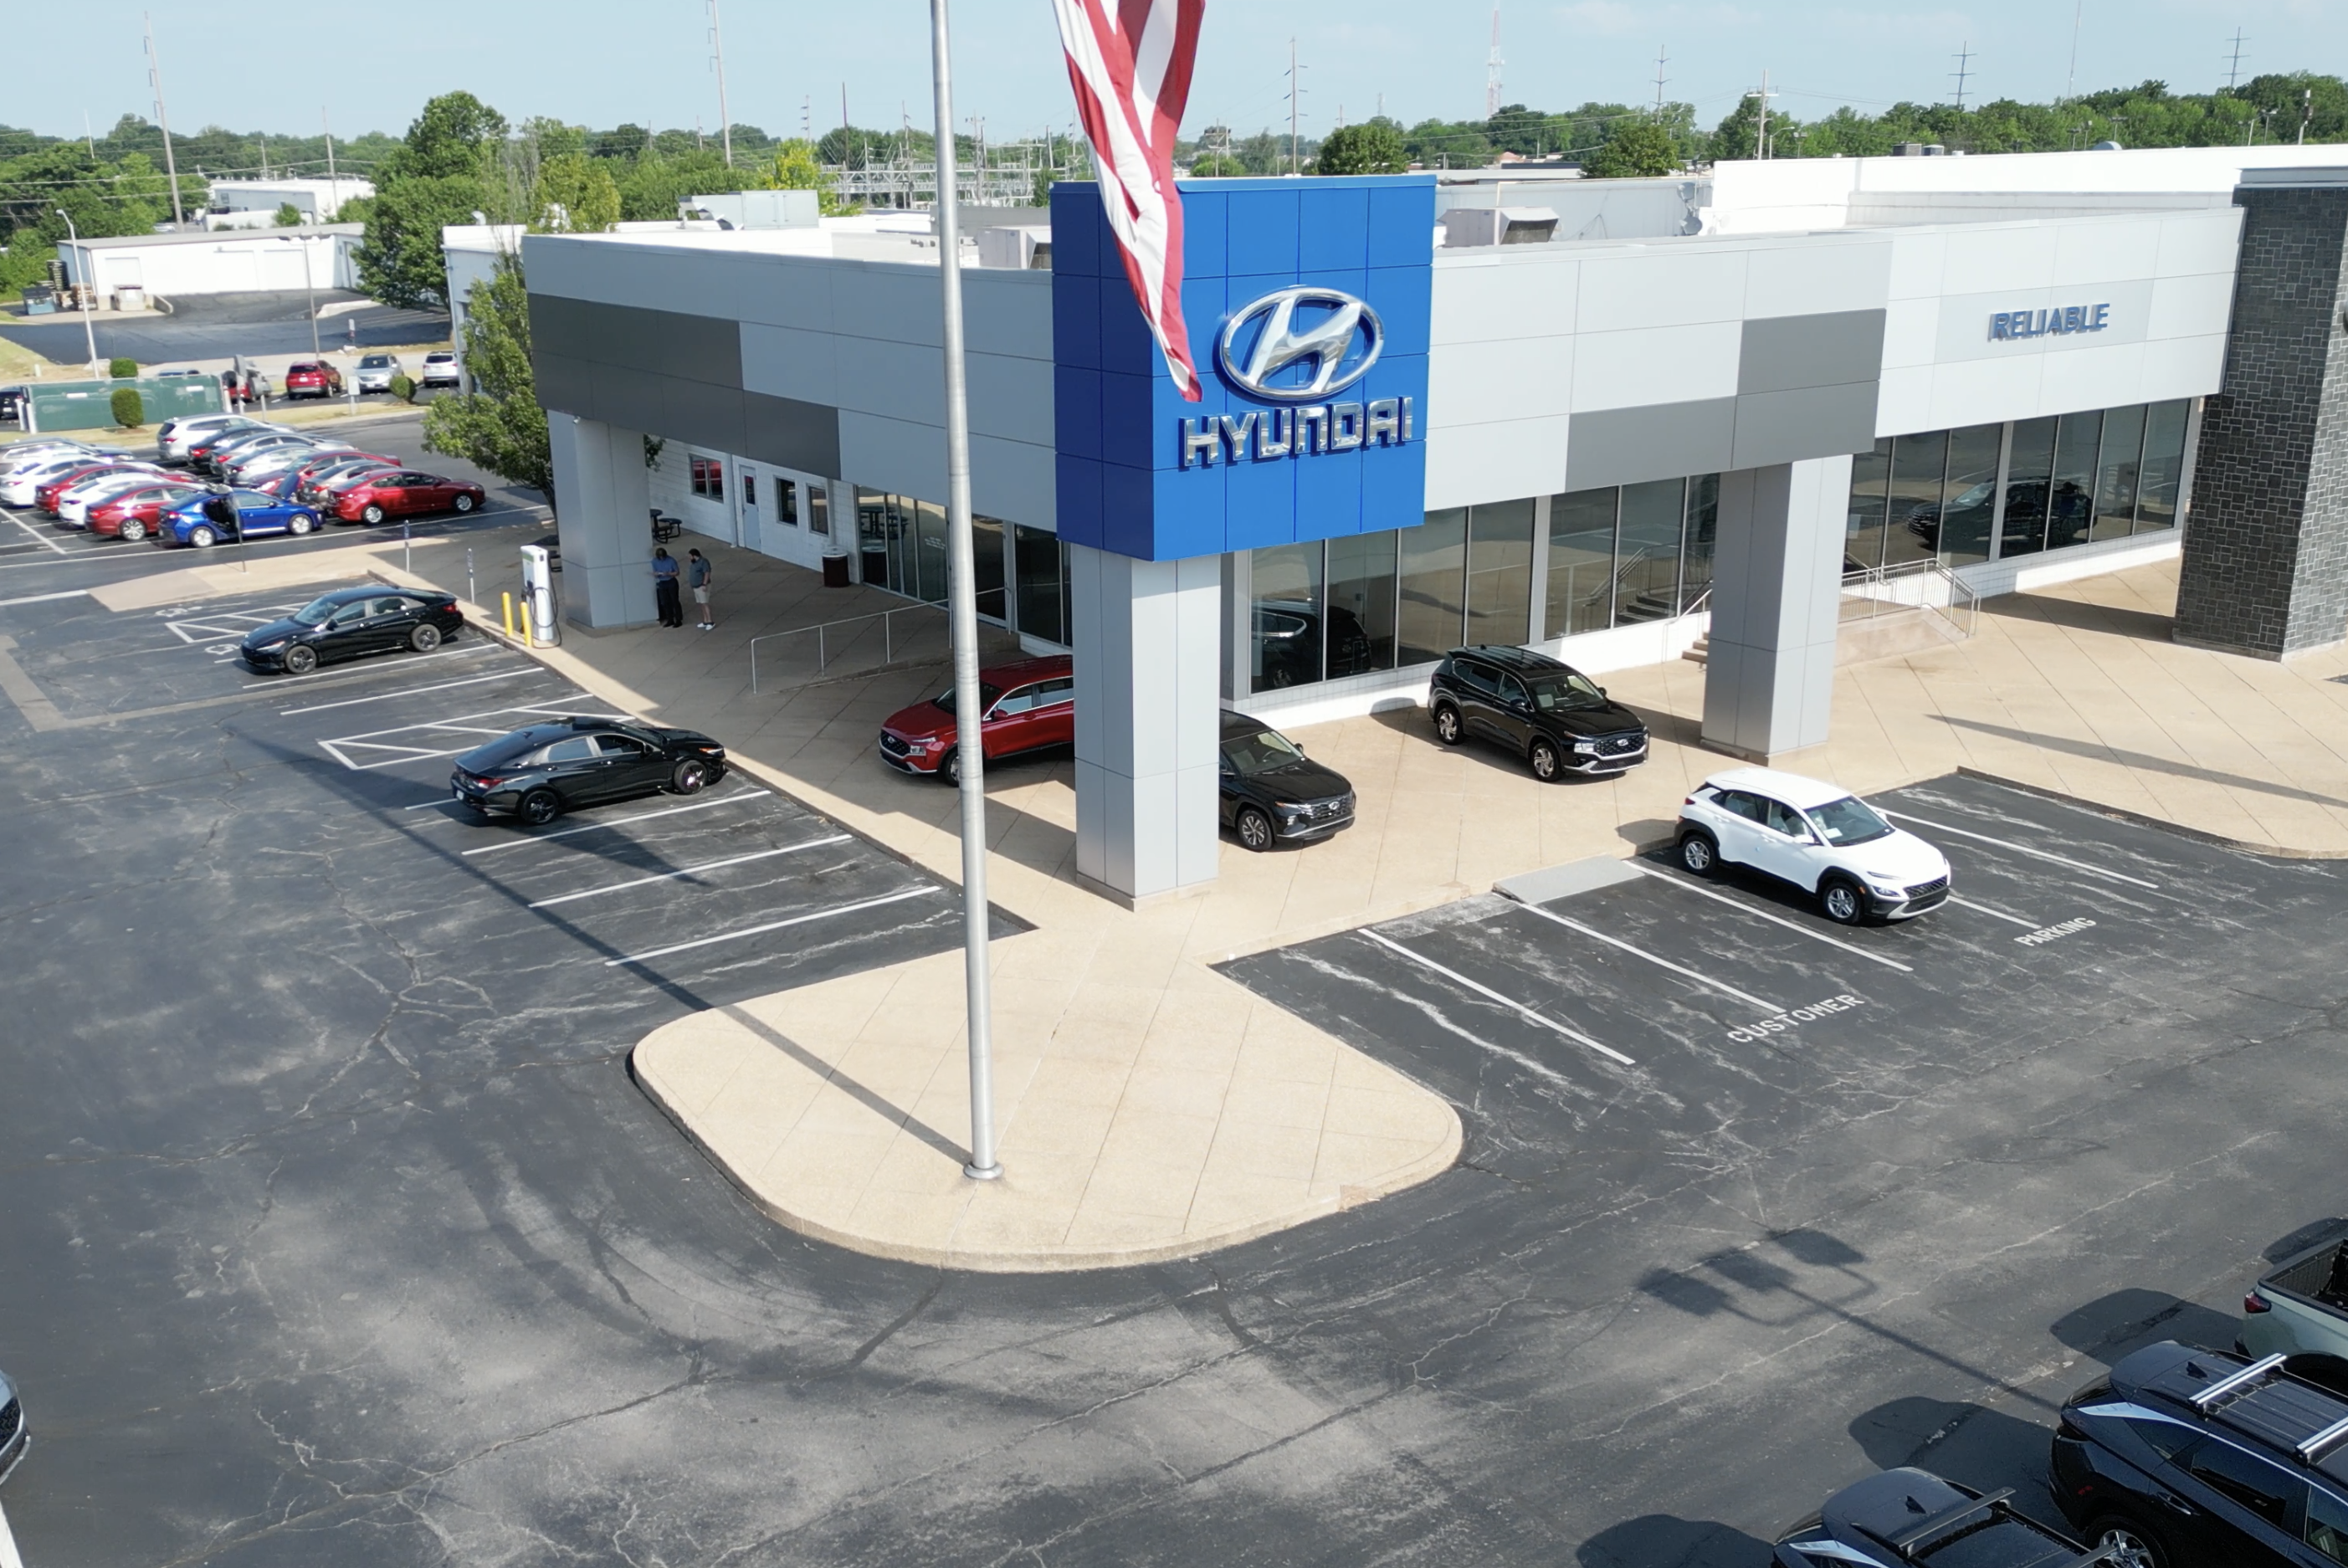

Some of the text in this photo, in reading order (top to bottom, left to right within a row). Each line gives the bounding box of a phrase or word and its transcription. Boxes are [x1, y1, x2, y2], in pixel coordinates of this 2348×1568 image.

[1988, 303, 2110, 341] RELIABLE
[1181, 396, 1413, 468] HYUNDAI
[2013, 917, 2096, 946] PARKING
[1727, 995, 1865, 1043] CUSTOMER
